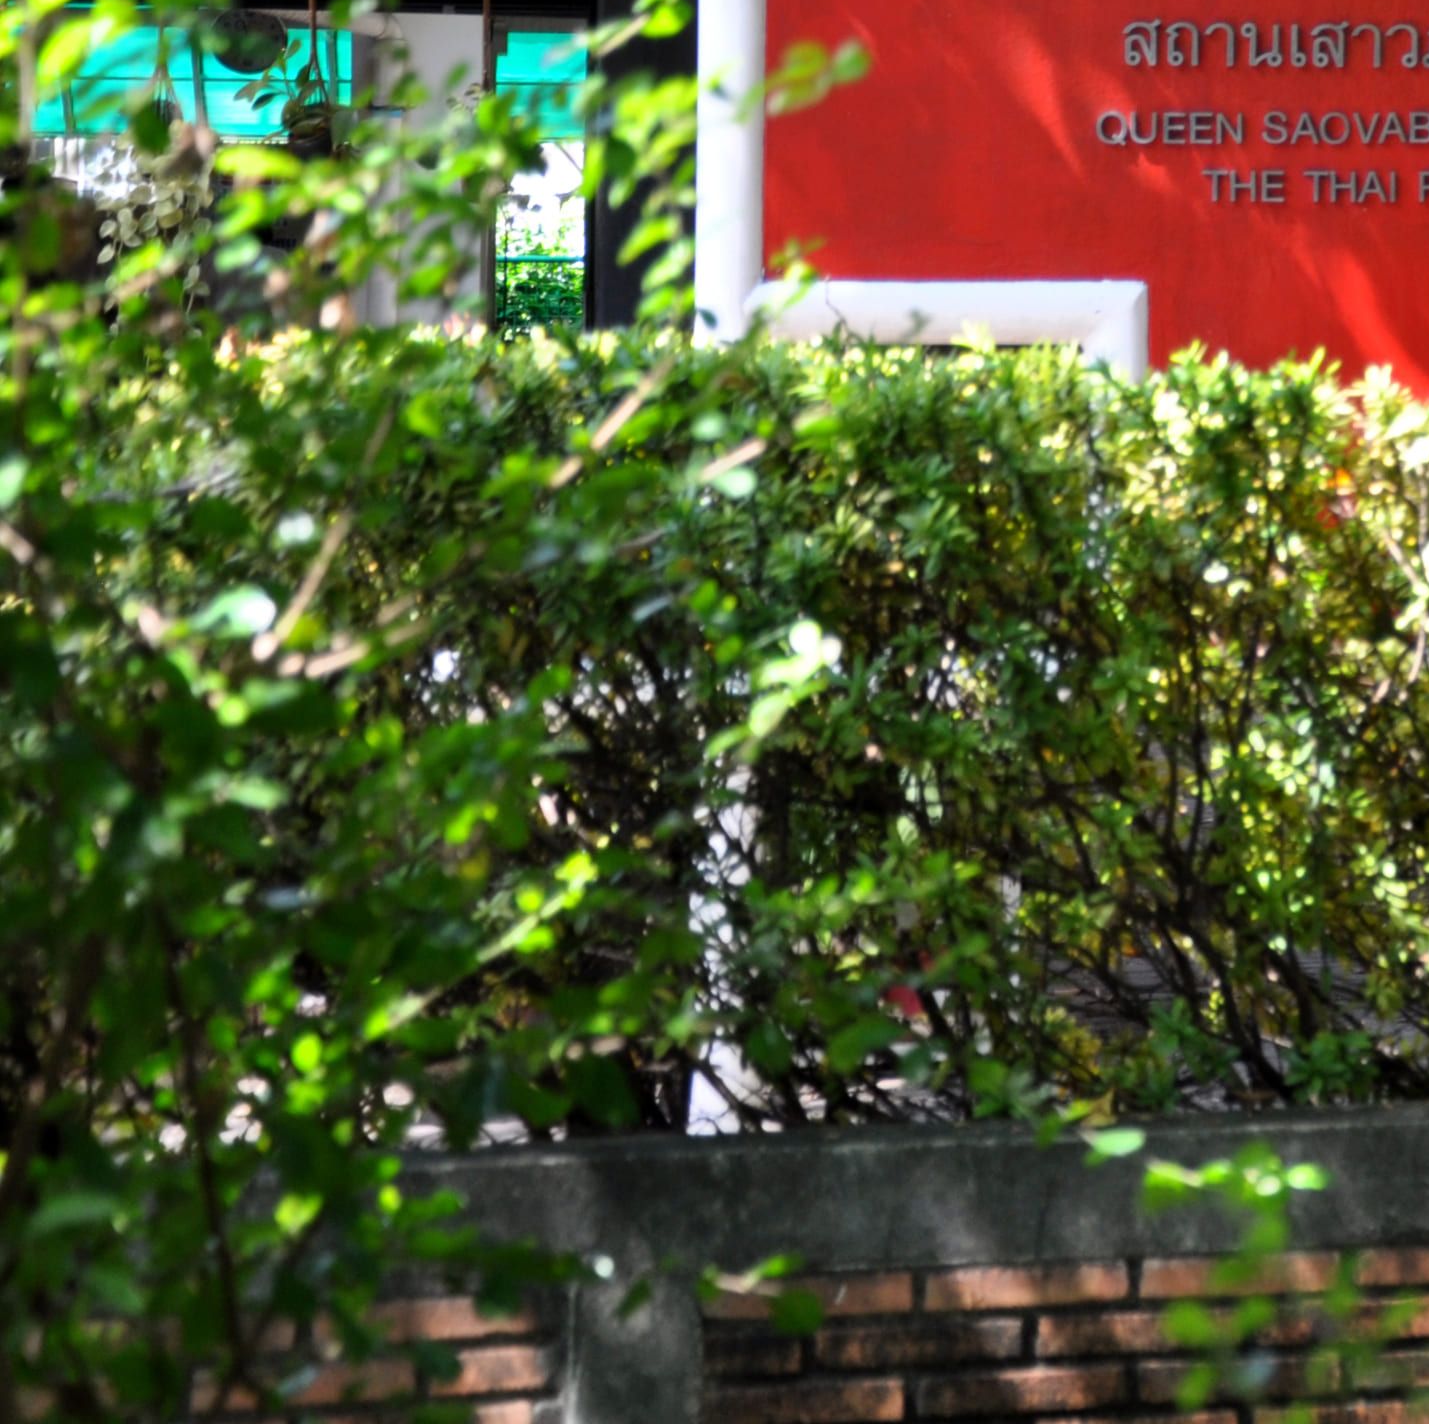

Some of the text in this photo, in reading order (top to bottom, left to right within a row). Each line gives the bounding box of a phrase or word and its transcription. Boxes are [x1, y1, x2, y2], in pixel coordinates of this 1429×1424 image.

[1095, 110, 1244, 146] QUEEN
[1202, 170, 1286, 204] THE
[1304, 170, 1397, 204] THAI
